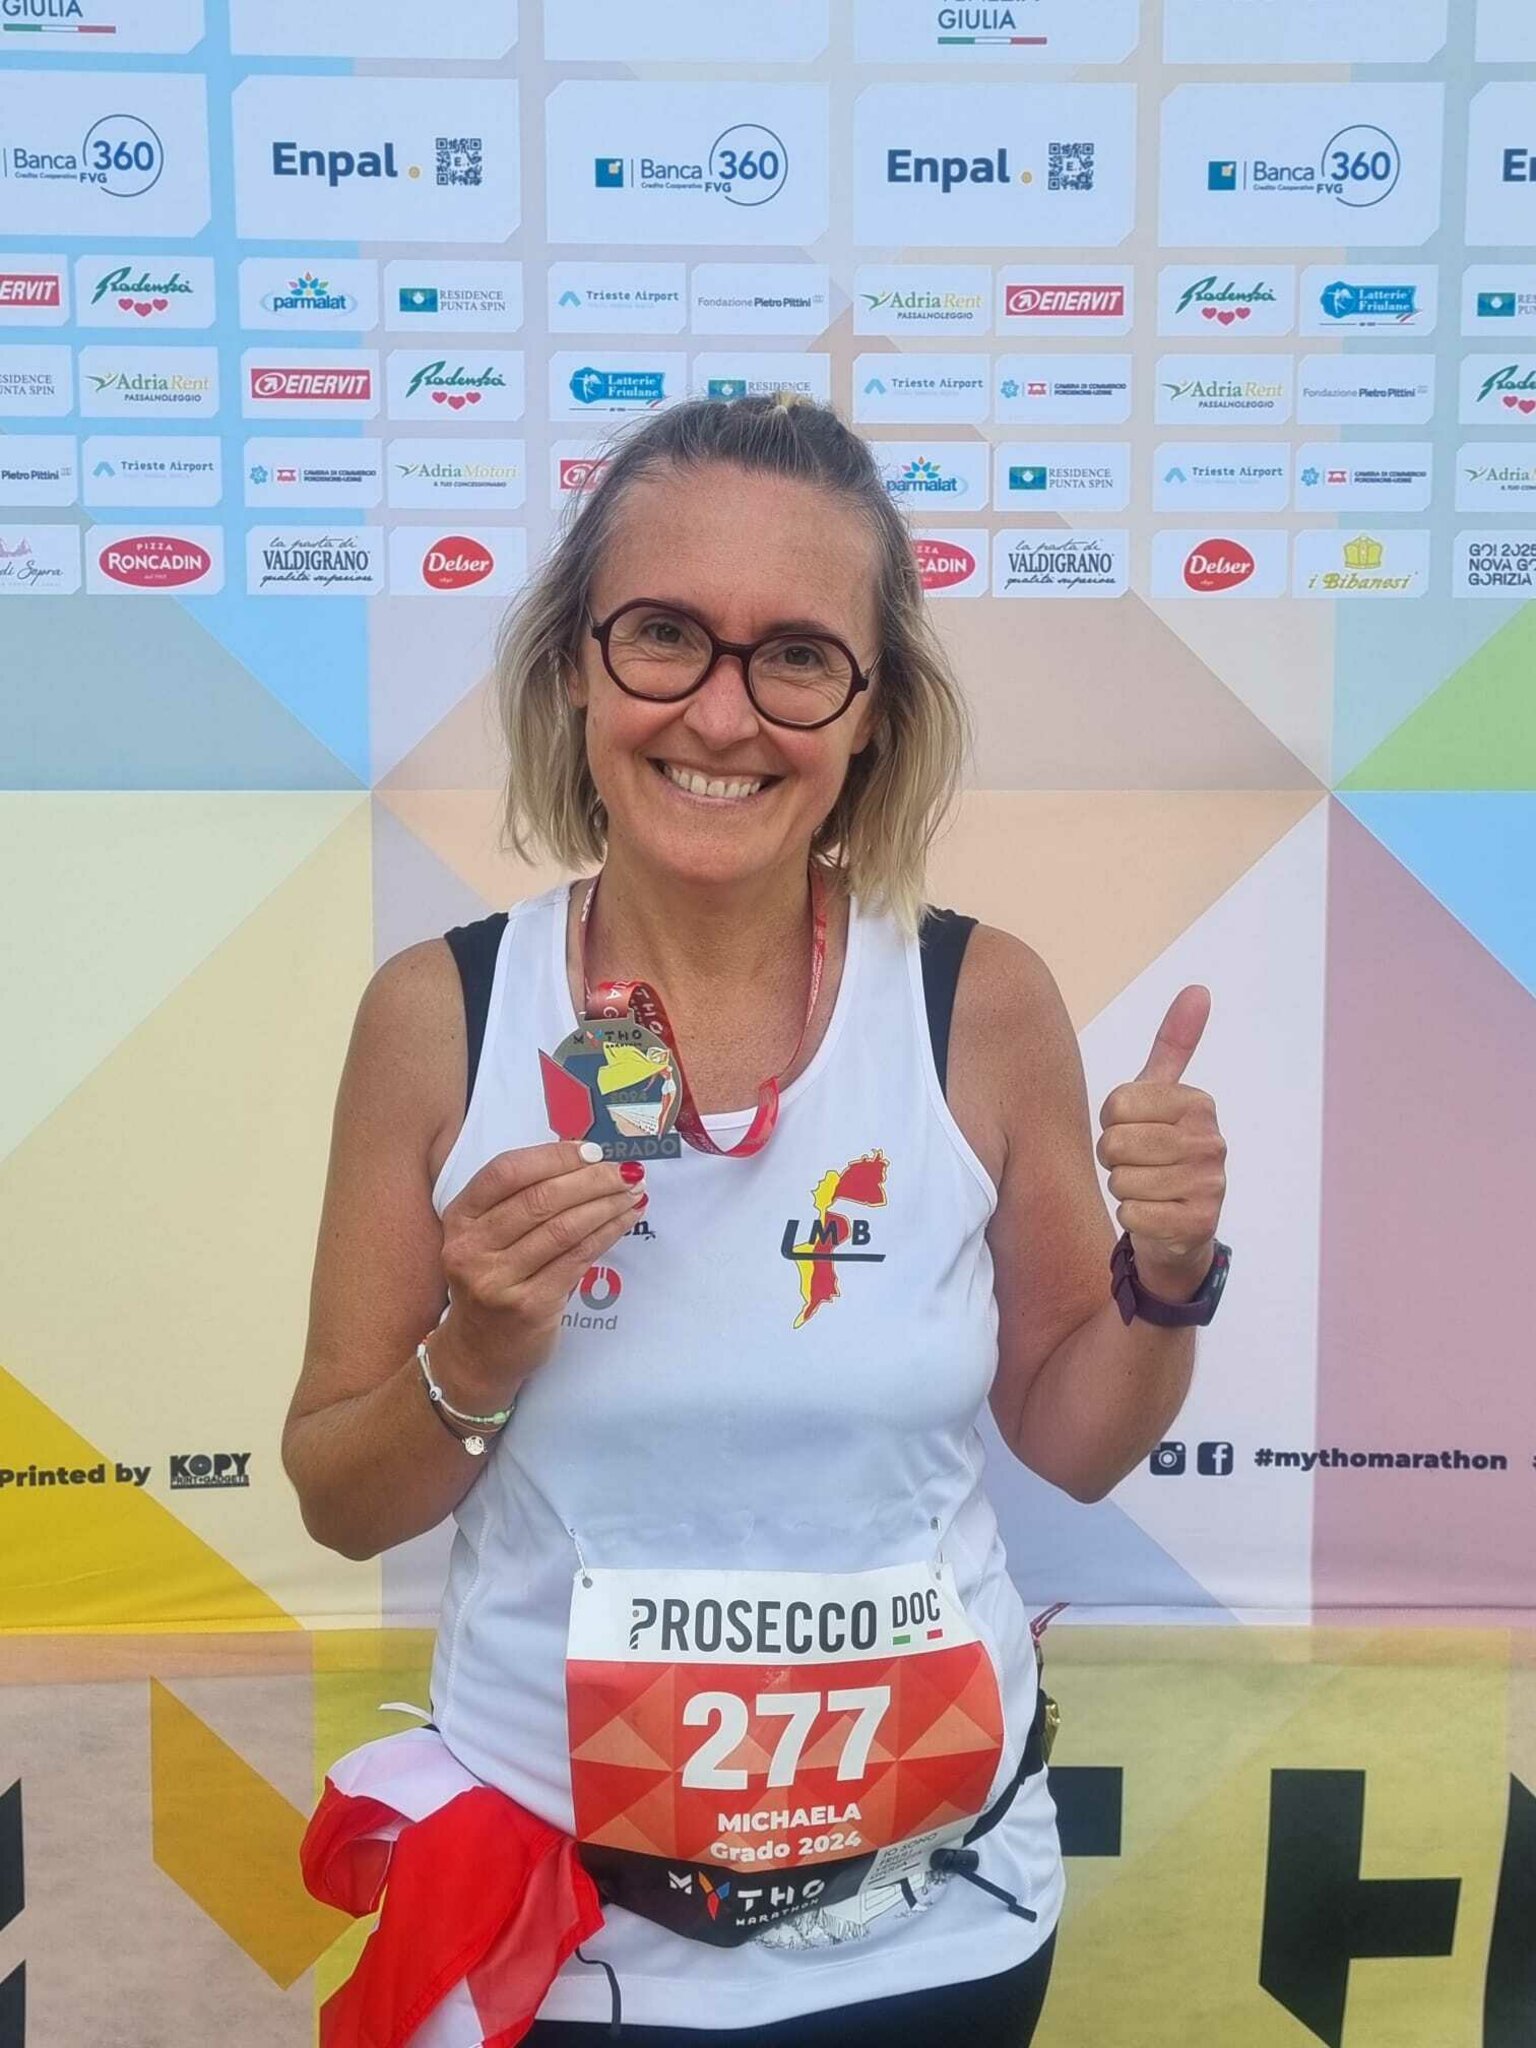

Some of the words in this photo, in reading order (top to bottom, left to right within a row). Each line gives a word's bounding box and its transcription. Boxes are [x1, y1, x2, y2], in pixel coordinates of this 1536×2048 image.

[938, 9, 1016, 29] GIULIA
[14, 148, 77, 170] Banca
[93, 141, 154, 171] 360
[640, 158, 702, 180] Banca
[718, 150, 779, 180] 360
[1253, 161, 1315, 181] Banca
[1331, 151, 1391, 182] 360
[80, 172, 107, 184] FVG
[704, 182, 731, 193] FVG
[1317, 183, 1343, 194] FVG
[440, 290, 504, 300] RESIDENCE
[586, 290, 630, 300] Trieste
[635, 290, 680, 303] Airport
[1038, 290, 1121, 311] ENERVIT
[1359, 289, 1408, 299] Latterie
[273, 293, 347, 312] parmalat
[440, 302, 478, 311] PUNTA
[480, 303, 506, 312] SPIN
[754, 297, 782, 307] Pietro
[1359, 300, 1410, 310] Friulane
[285, 374, 368, 395] ENERVIT
[608, 375, 656, 385] Latterie
[891, 378, 935, 388] Trieste
[939, 378, 984, 391] Airport
[29, 385, 55, 395] SPIN
[608, 386, 659, 396] Friulane
[1359, 388, 1387, 397] Pietro
[121, 461, 165, 471] Trieste
[170, 461, 214, 472] Airport
[1049, 468, 1111, 477] RESIDENCE
[1192, 467, 1235, 476] Trieste
[1240, 467, 1283, 479] Airport
[1, 470, 30, 480] Pietro
[886, 477, 958, 493] parmalat
[1049, 479, 1087, 488] PUNTA
[1089, 479, 1113, 488] SPIN
[136, 542, 173, 551] PIZZA
[269, 537, 286, 548] la
[339, 535, 358, 548] di
[1015, 540, 1032, 551] la
[1083, 540, 1101, 551] di
[108, 552, 202, 574] RONCADIN
[262, 550, 369, 570] VALDIGRANO
[429, 552, 490, 571] Delser
[1008, 553, 1112, 573] VALDIGRANO
[1189, 555, 1251, 574] Delser
[1469, 558, 1512, 571] NOVA
[17, 559, 64, 586] Sopra
[1468, 573, 1532, 585] GORIZIA
[1308, 574, 1318, 589] i
[1322, 572, 1412, 589] Bibanesi
[170, 1453, 252, 1478] KOPY
[1254, 1447, 1508, 1472] #mythomarathon
[0, 1464, 105, 1487] Printed
[115, 1462, 151, 1486] by
[629, 1598, 877, 1655] PROSECCO
[892, 1588, 941, 1629] DOC
[682, 1685, 891, 1790] 277
[717, 1802, 861, 1833] MICHAELA
[710, 1840, 790, 1863] Grado
[798, 1831, 862, 1856] 2024
[736, 1898, 820, 1927] MARATHON
